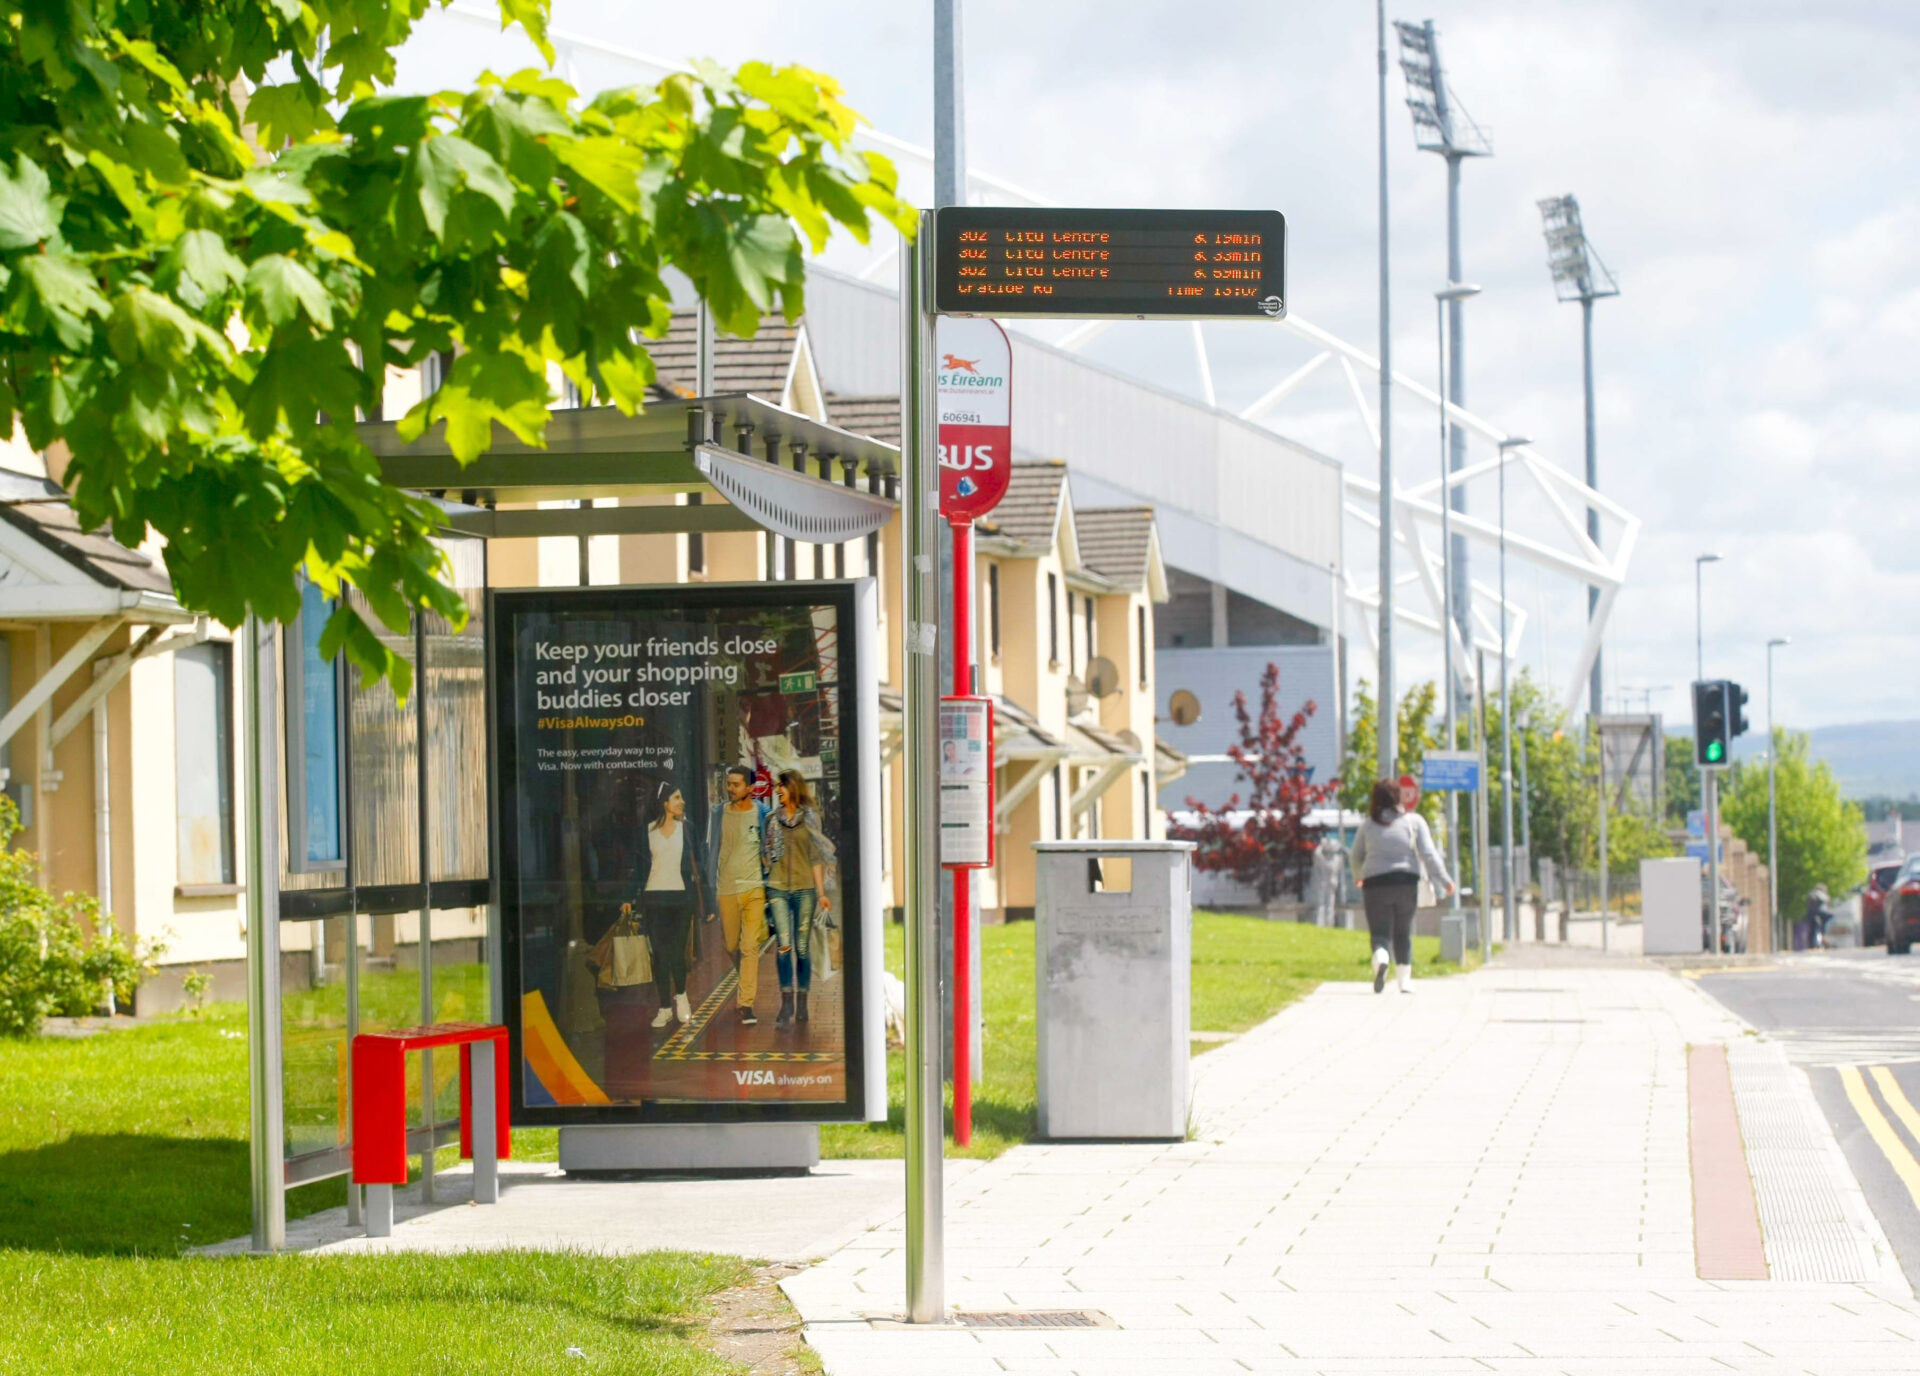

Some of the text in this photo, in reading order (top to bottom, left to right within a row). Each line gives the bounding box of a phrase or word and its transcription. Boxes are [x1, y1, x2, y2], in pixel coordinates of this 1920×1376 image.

[943, 412, 982, 423] 606941
[535, 635, 778, 664] Keep your friends close
[536, 661, 738, 688] and your shopping
[537, 687, 692, 710] buddies closer
[537, 714, 645, 731] #VisaAlwaysOn
[537, 748, 555, 758] The
[581, 746, 622, 759] everyday
[624, 747, 644, 757] way
[645, 746, 656, 755] to
[657, 746, 677, 757] pay.
[537, 759, 658, 771] Visa. Now with contactless
[732, 1070, 833, 1087] VISA always on
